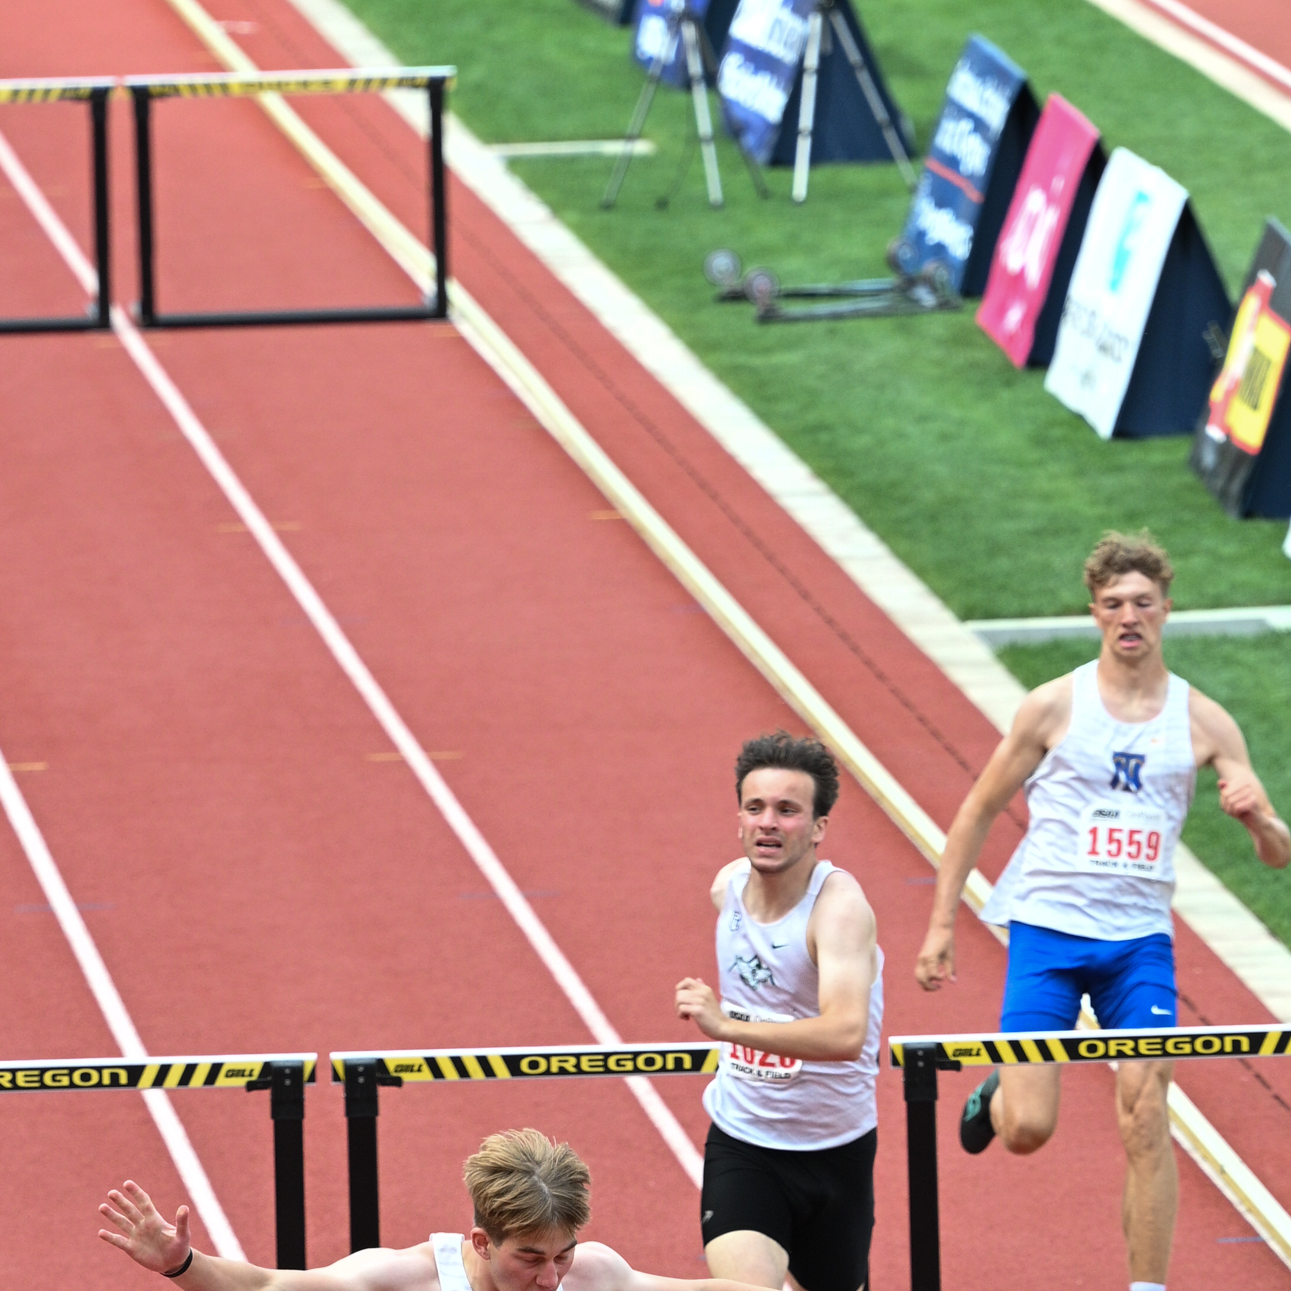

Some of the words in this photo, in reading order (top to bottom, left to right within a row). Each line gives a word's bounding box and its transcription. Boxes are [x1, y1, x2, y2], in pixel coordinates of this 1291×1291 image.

[1087, 826, 1161, 861] 1559
[1078, 1035, 1250, 1058] OREGON
[224, 1067, 257, 1080] GILL
[520, 1052, 692, 1075] OREGON
